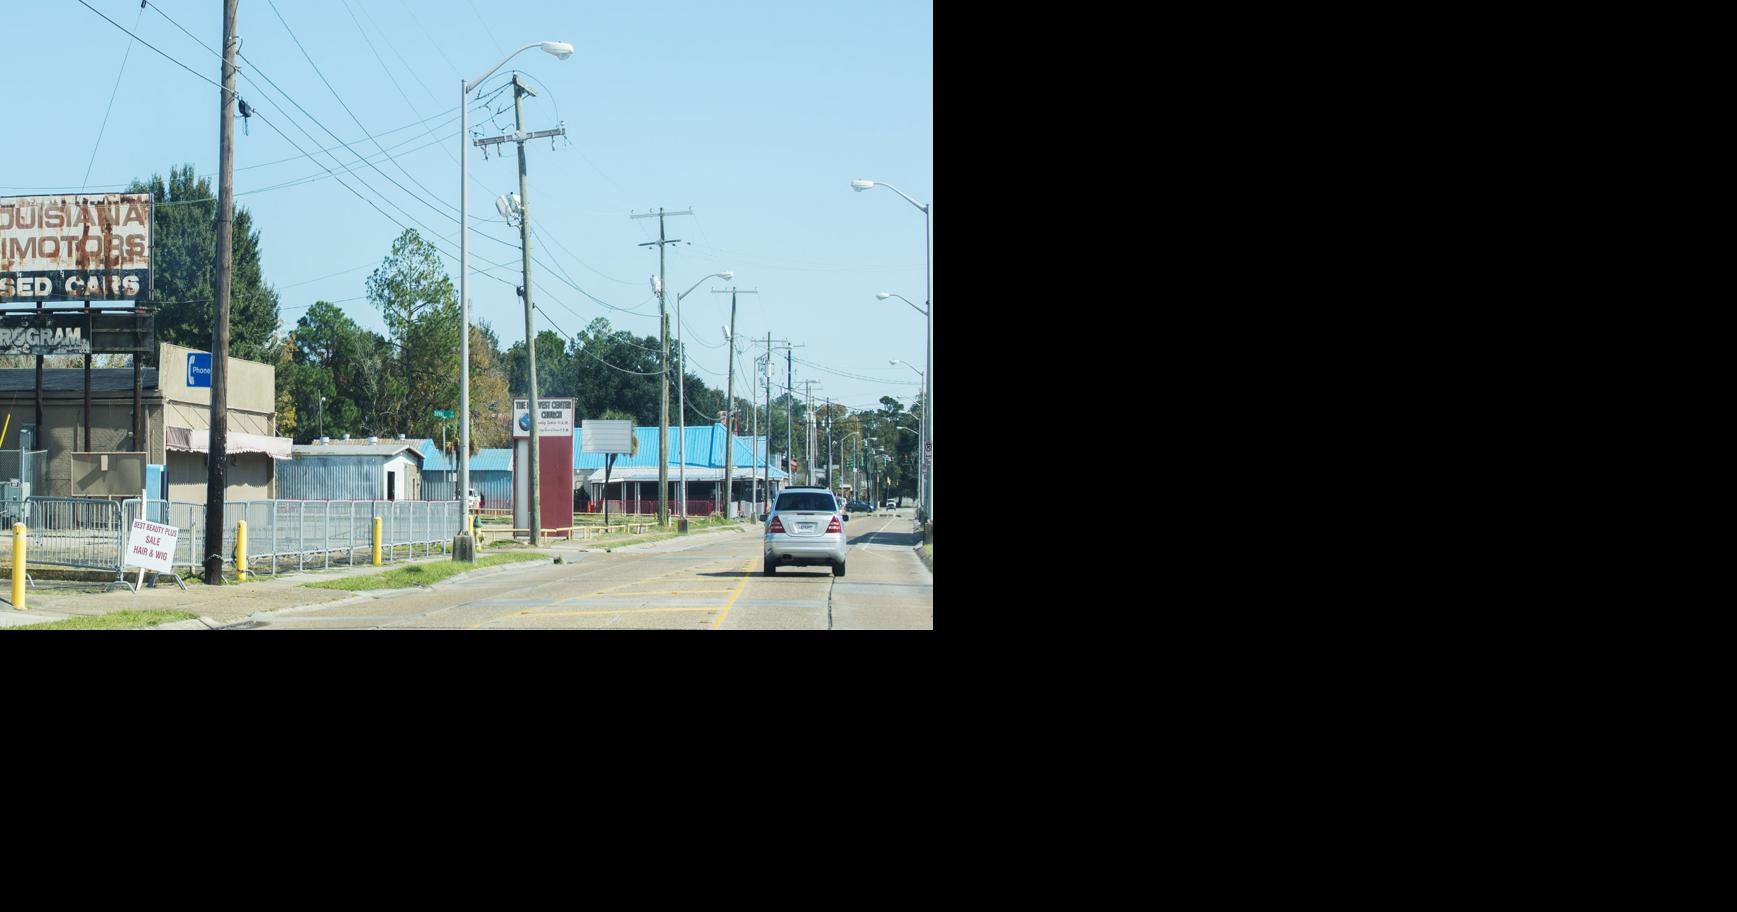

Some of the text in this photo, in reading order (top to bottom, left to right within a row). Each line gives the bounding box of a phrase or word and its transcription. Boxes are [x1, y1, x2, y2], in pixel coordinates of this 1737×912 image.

[65, 275, 140, 299] CARS
[146, 524, 164, 533] BEAUTY
[165, 528, 177, 537] PLUS
[146, 536, 160, 546] SALE
[134, 546, 148, 556] HAIR
[156, 551, 167, 560] WIG
